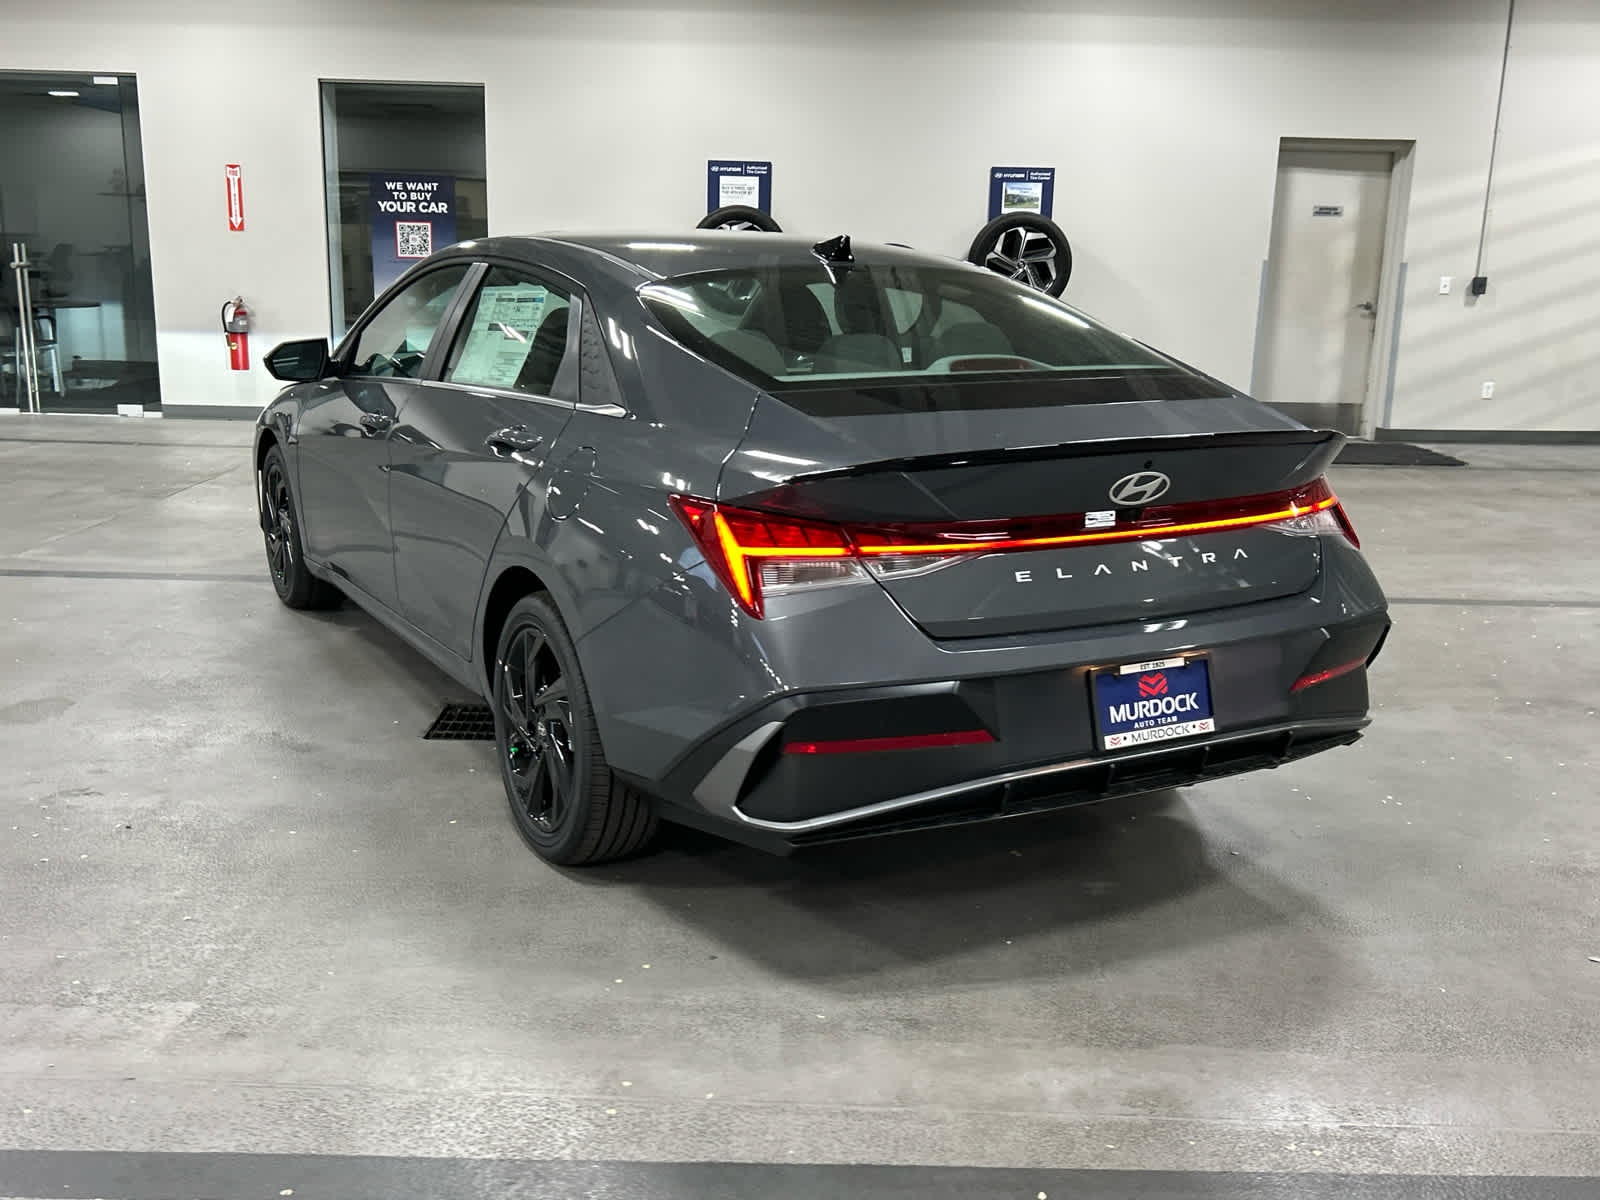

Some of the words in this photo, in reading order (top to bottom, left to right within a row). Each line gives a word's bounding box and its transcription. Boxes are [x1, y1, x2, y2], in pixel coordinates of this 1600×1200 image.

[385, 182, 403, 190] WE
[406, 182, 439, 191] WANT
[392, 192, 407, 200] TO
[410, 192, 432, 200] BUY
[378, 201, 416, 212] YOUR
[419, 202, 448, 213] CAR
[1015, 548, 1248, 583] ELANTRA
[1109, 692, 1199, 723] MURDOCK
[1134, 720, 1155, 729] AUTO
[1157, 715, 1178, 725] TEAM
[1131, 724, 1190, 743] MURDOCK
